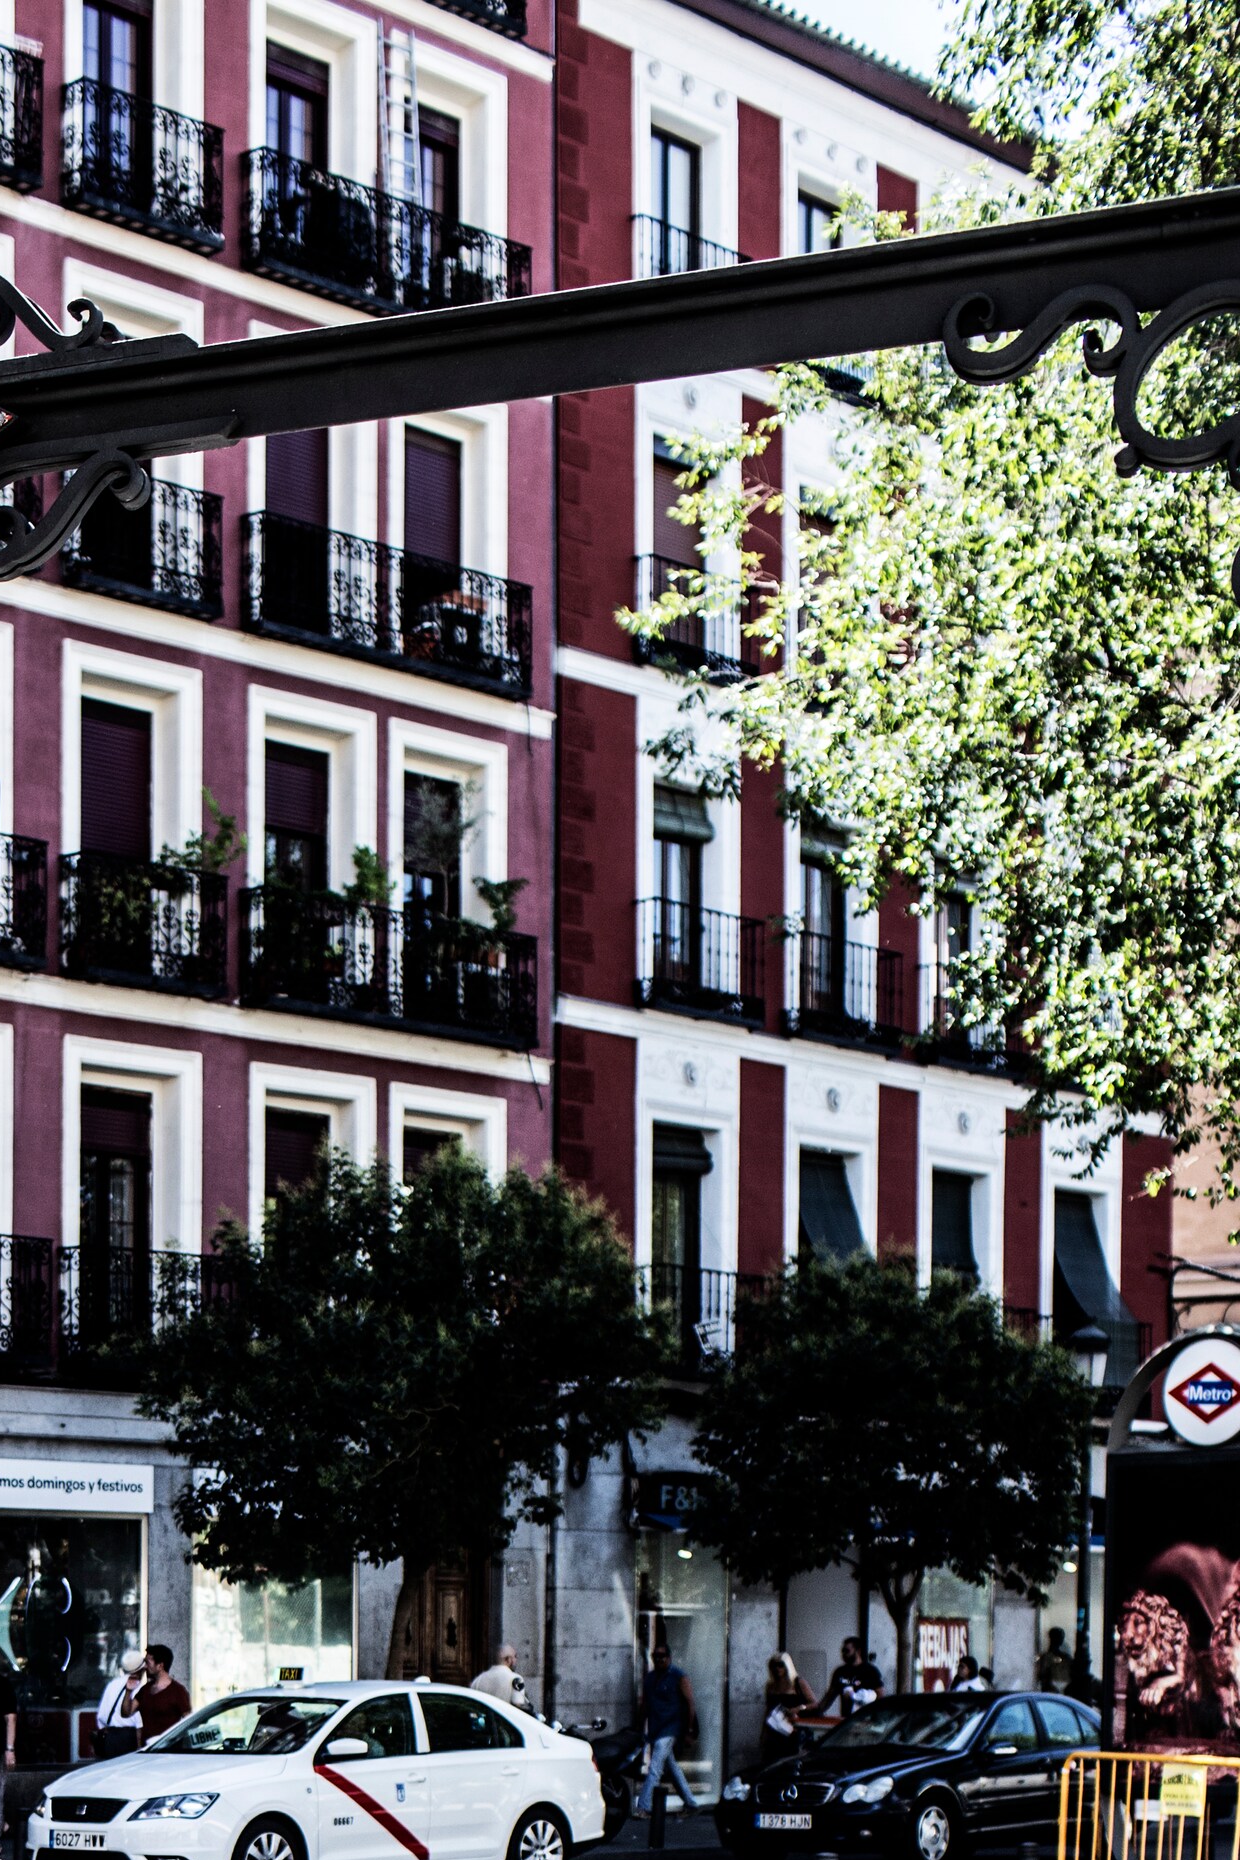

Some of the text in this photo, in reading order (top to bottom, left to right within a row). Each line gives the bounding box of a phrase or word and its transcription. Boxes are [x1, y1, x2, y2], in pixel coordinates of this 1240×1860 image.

[1189, 1384, 1232, 1402] Metro
[27, 1476, 86, 1494] domingos
[89, 1481, 95, 1494] y
[97, 1478, 144, 1493] festivos
[920, 1624, 967, 1682] REBAJAS
[281, 1668, 298, 1680] TAXI
[56, 1833, 80, 1846] 6027
